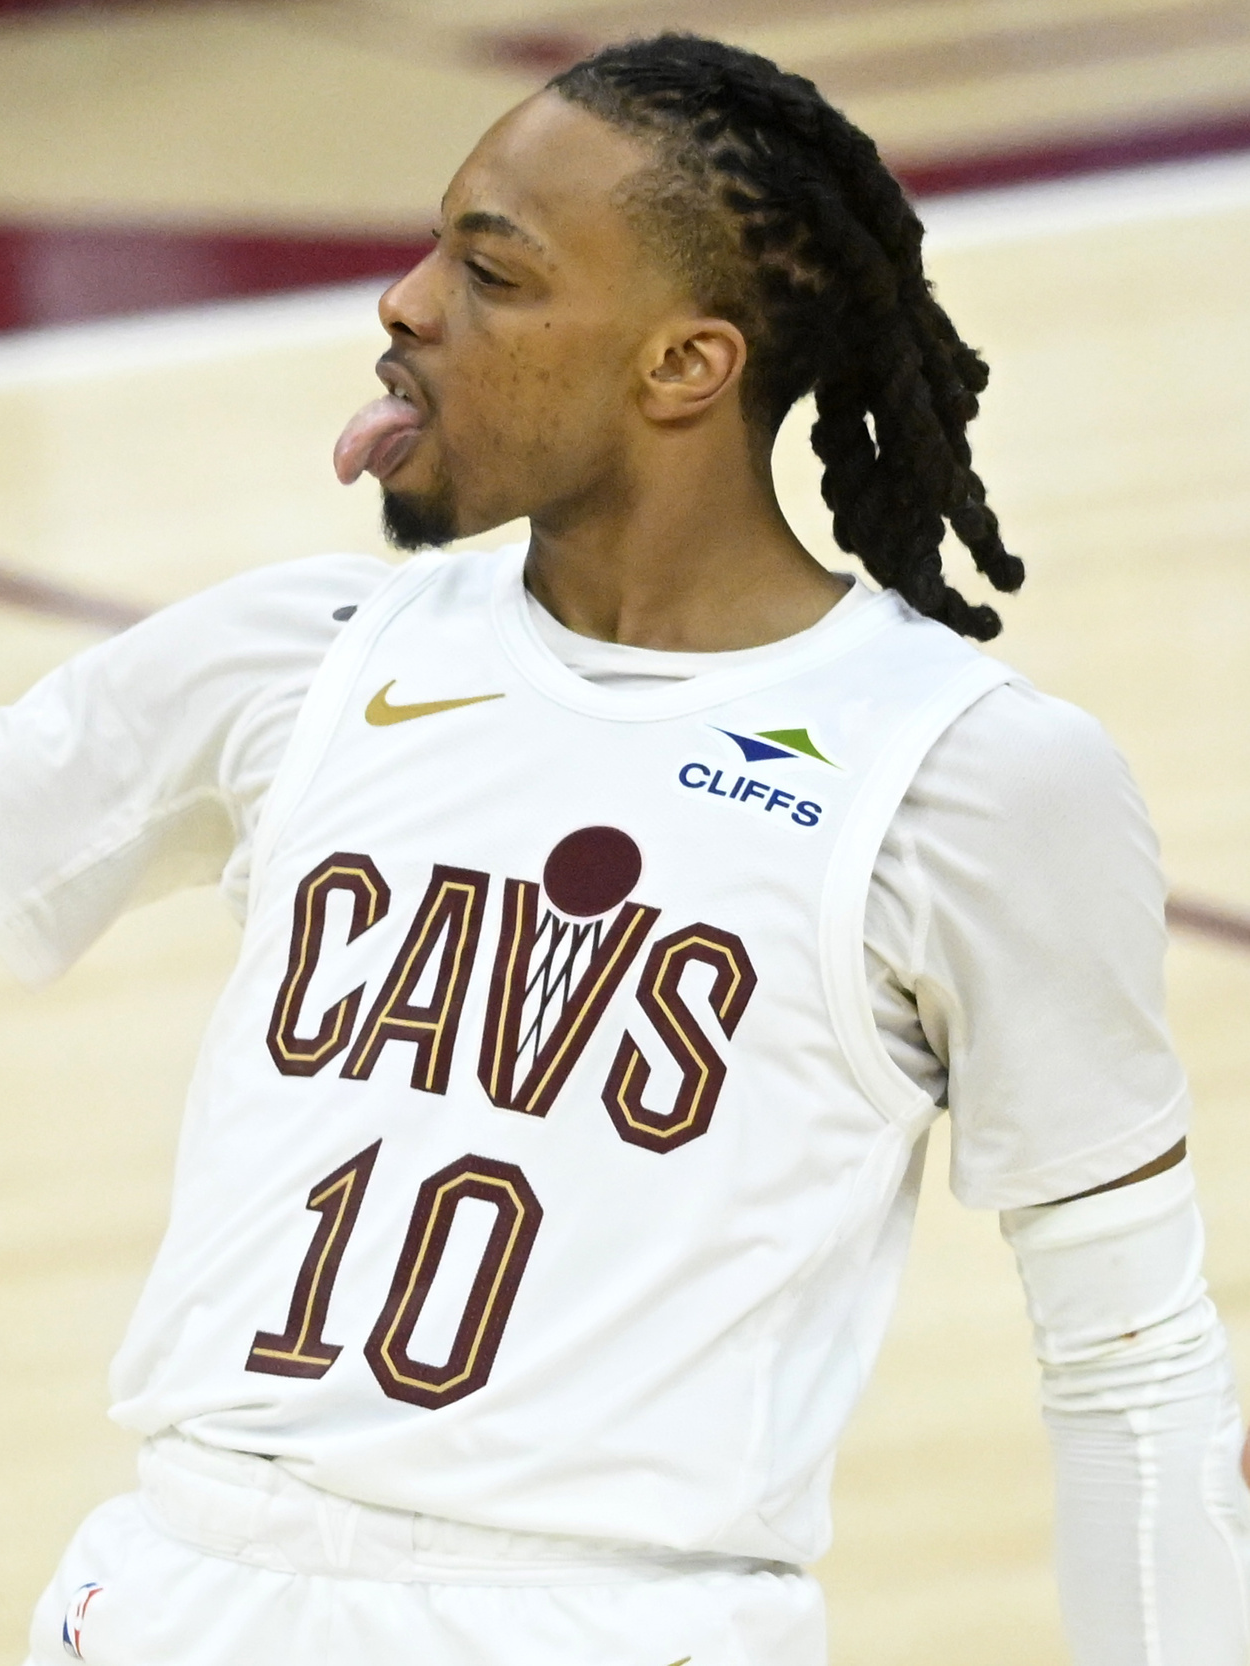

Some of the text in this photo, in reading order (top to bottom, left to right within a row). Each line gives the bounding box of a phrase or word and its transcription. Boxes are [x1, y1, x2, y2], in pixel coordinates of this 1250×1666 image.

[679, 762, 822, 827] CLIFFS
[266, 850, 758, 1155] CAVS
[244, 1138, 545, 1411] 10
